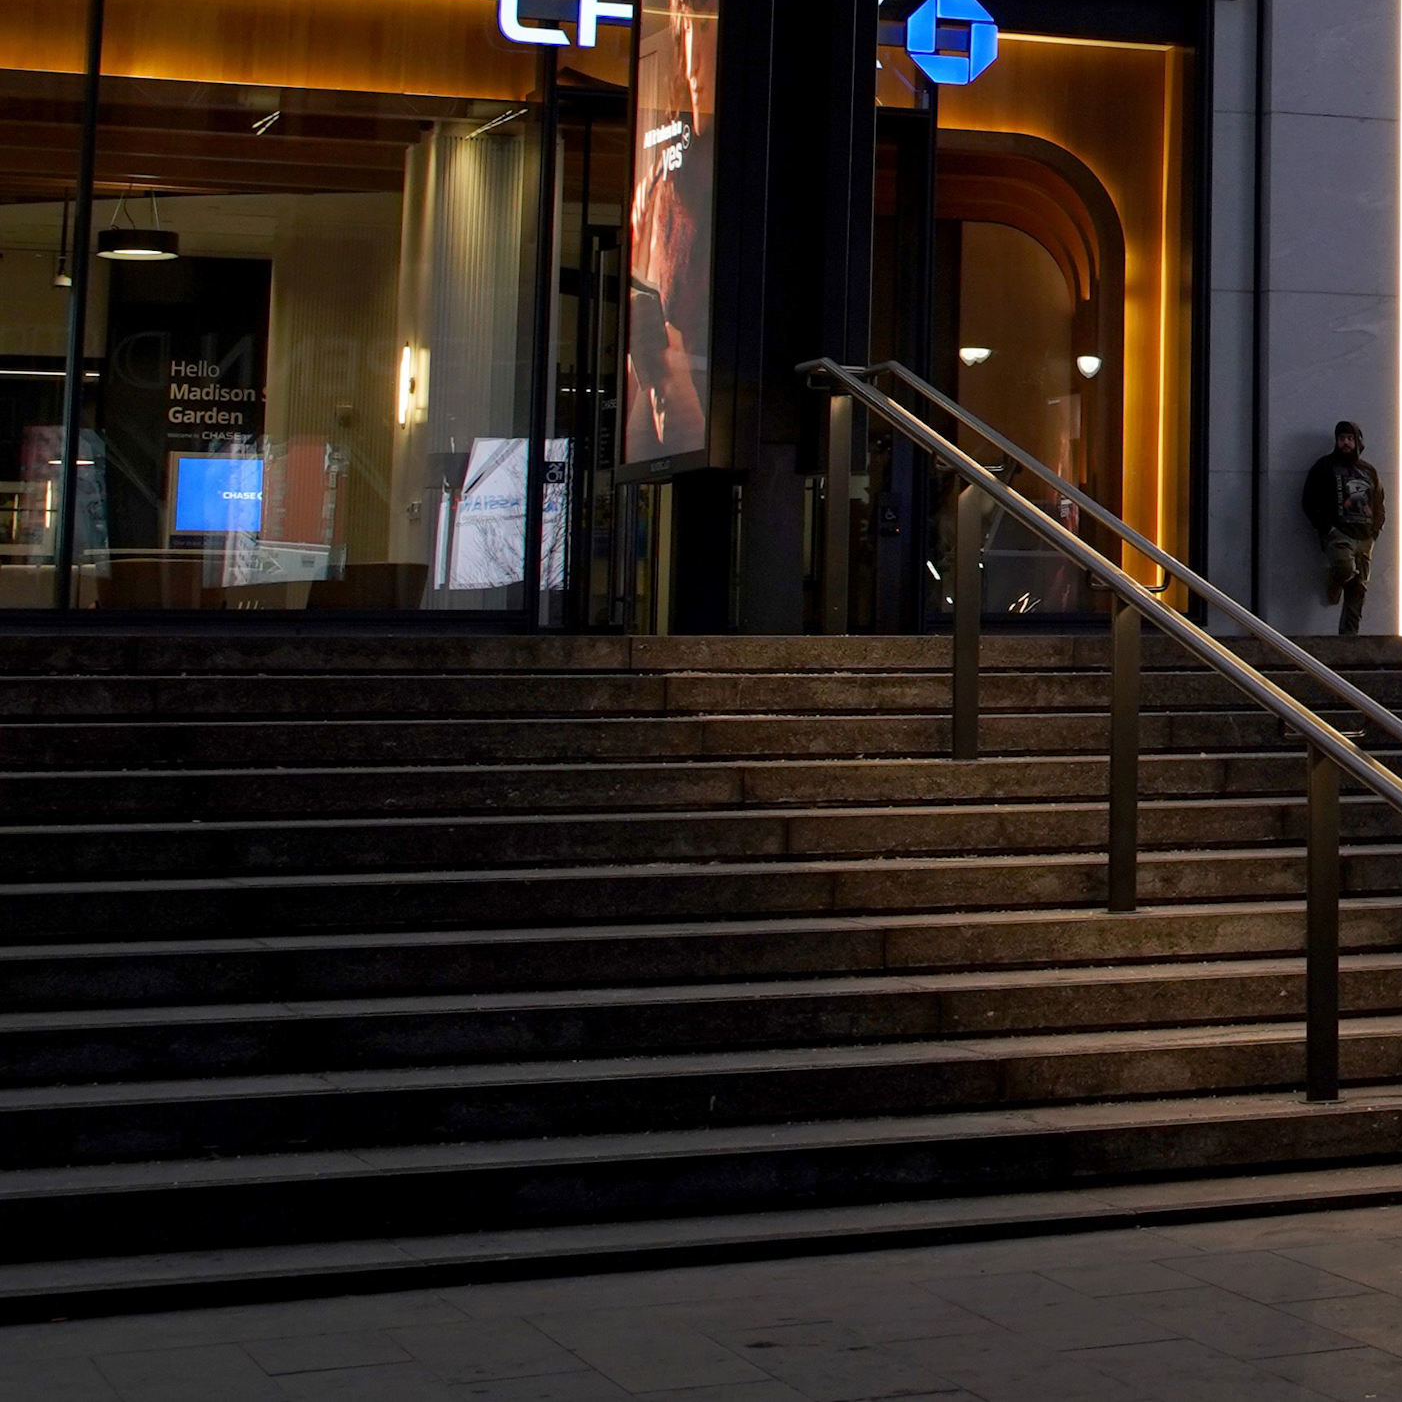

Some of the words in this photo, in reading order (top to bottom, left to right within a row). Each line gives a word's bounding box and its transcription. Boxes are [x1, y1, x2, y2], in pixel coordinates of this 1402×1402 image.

[661, 142, 683, 182] yes
[170, 360, 220, 378] Hello
[169, 382, 256, 401] Madison
[168, 406, 243, 425] Garden
[202, 431, 241, 441] CHASE
[222, 491, 257, 500] CHASE
